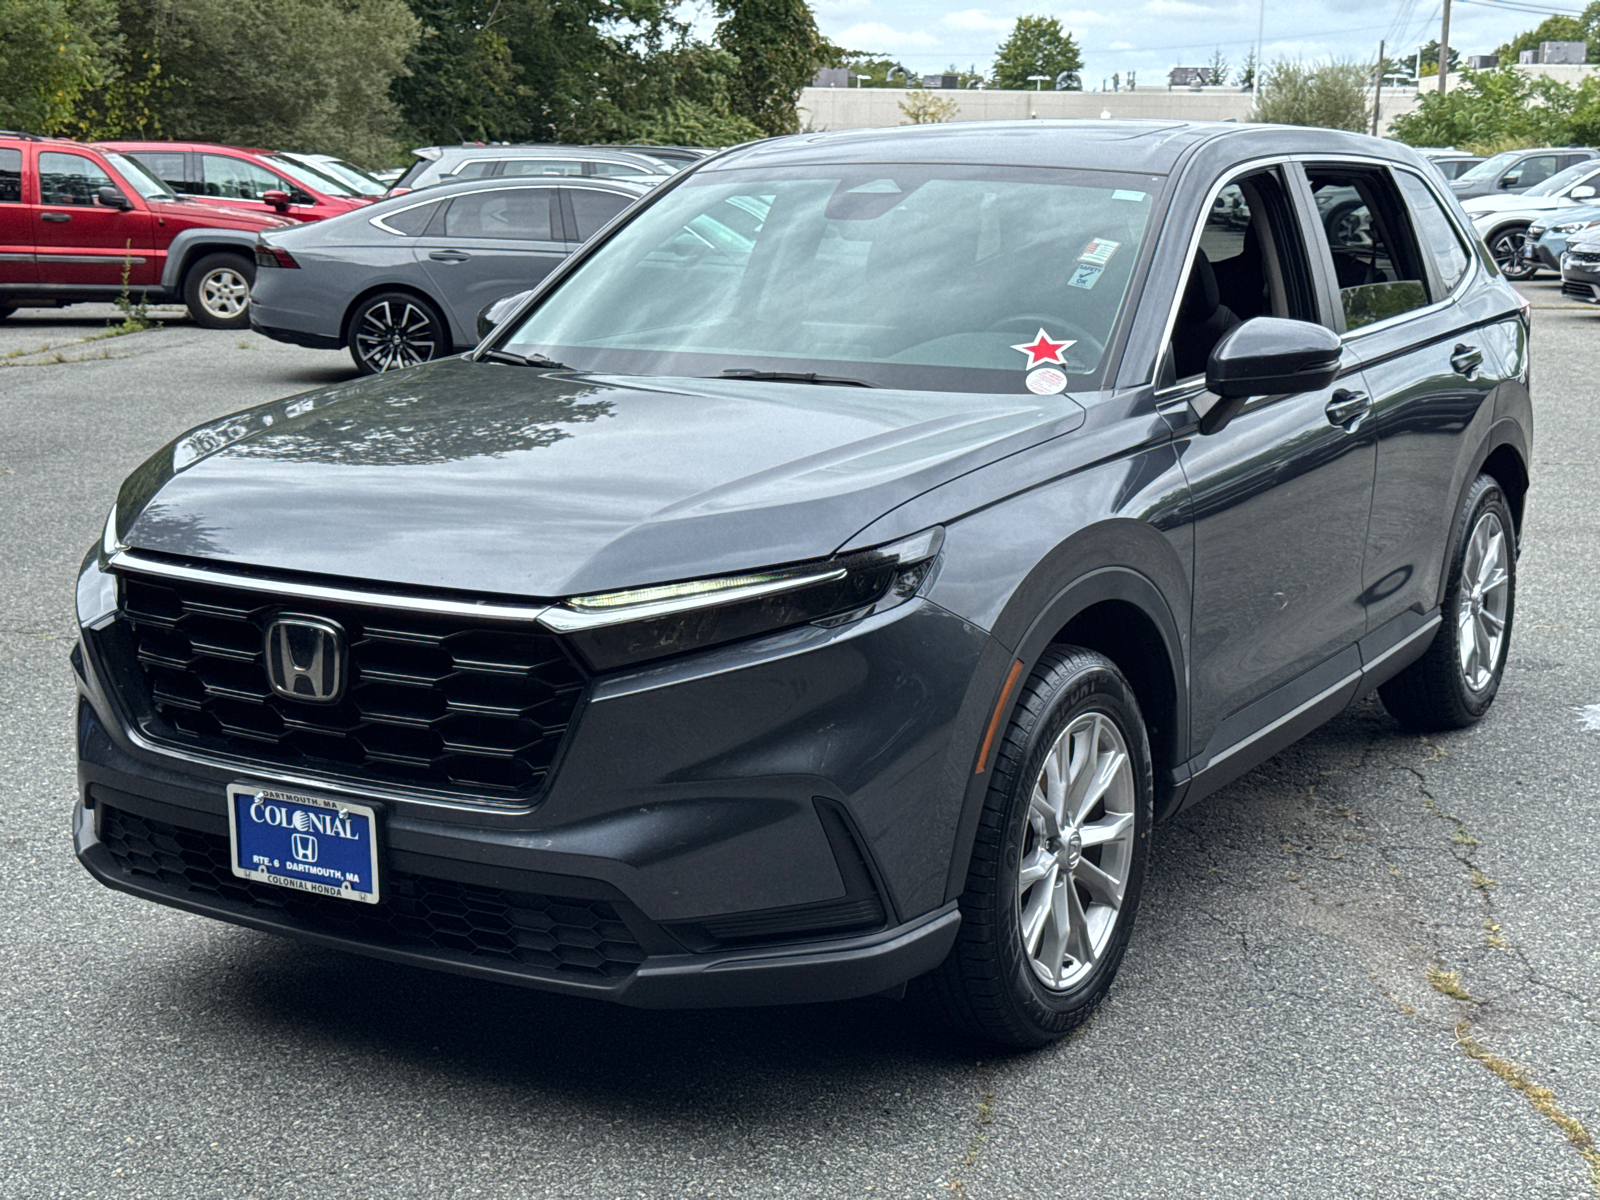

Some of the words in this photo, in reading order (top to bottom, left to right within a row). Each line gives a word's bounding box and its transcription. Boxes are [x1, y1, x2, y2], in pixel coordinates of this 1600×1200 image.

[1079, 265, 1103, 273] SAFETY
[1052, 679, 1096, 731] SPORT
[323, 800, 338, 809] MA
[250, 802, 359, 840] COLONIAL
[252, 855, 272, 867] RTE.
[273, 860, 280, 868] 6
[286, 861, 344, 881] DARTMOUTH,
[345, 872, 360, 883] MA
[267, 874, 309, 891] COLONIAL
[310, 883, 343, 897] HONDA
